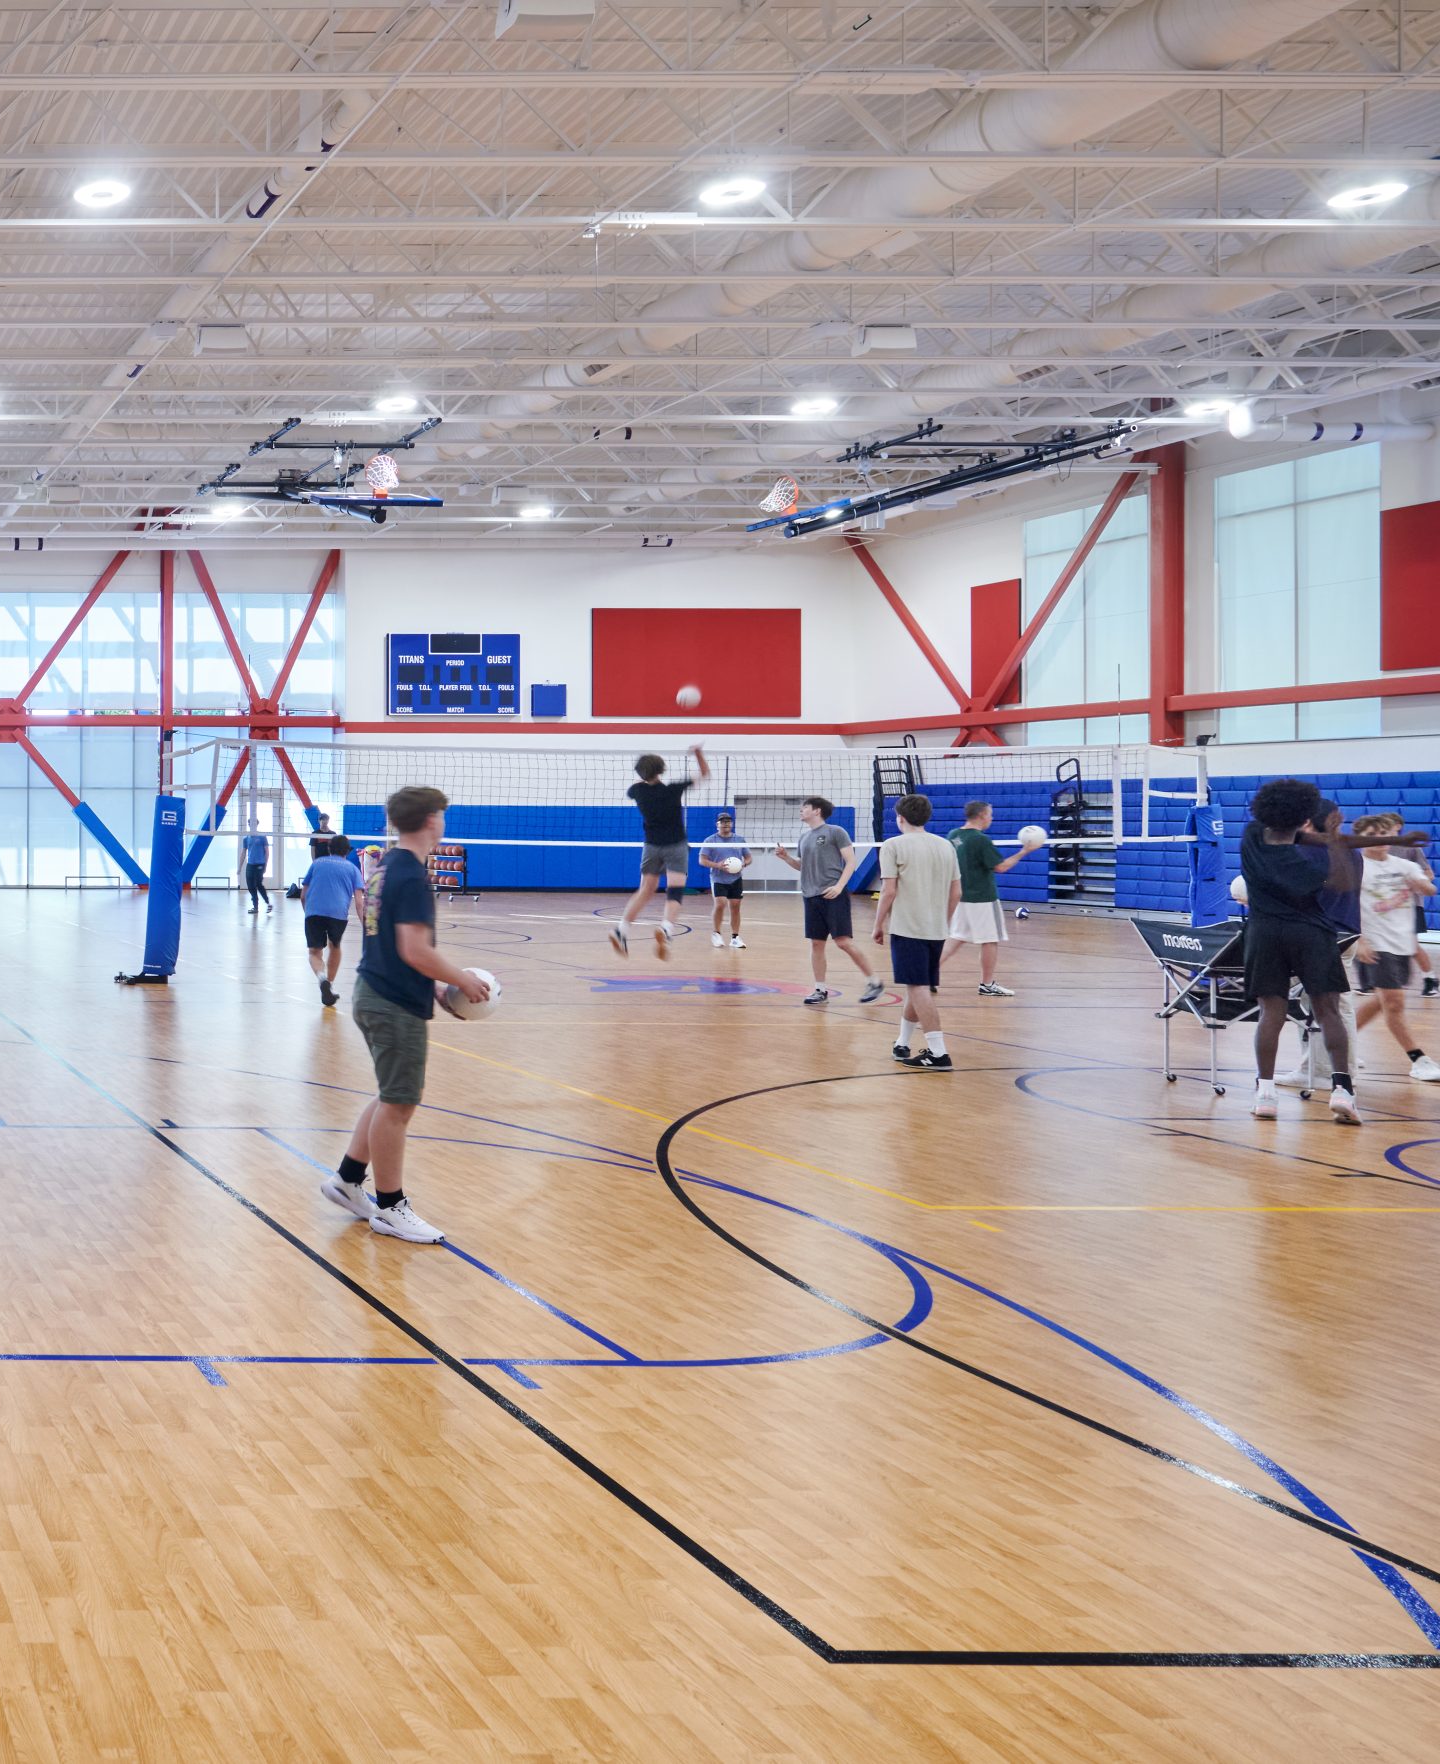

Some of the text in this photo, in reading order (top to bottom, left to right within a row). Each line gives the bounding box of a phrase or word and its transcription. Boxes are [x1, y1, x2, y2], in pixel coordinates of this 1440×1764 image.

[399, 656, 424, 664] TITANS
[487, 656, 511, 664] GUEST
[1162, 933, 1203, 951] molten
